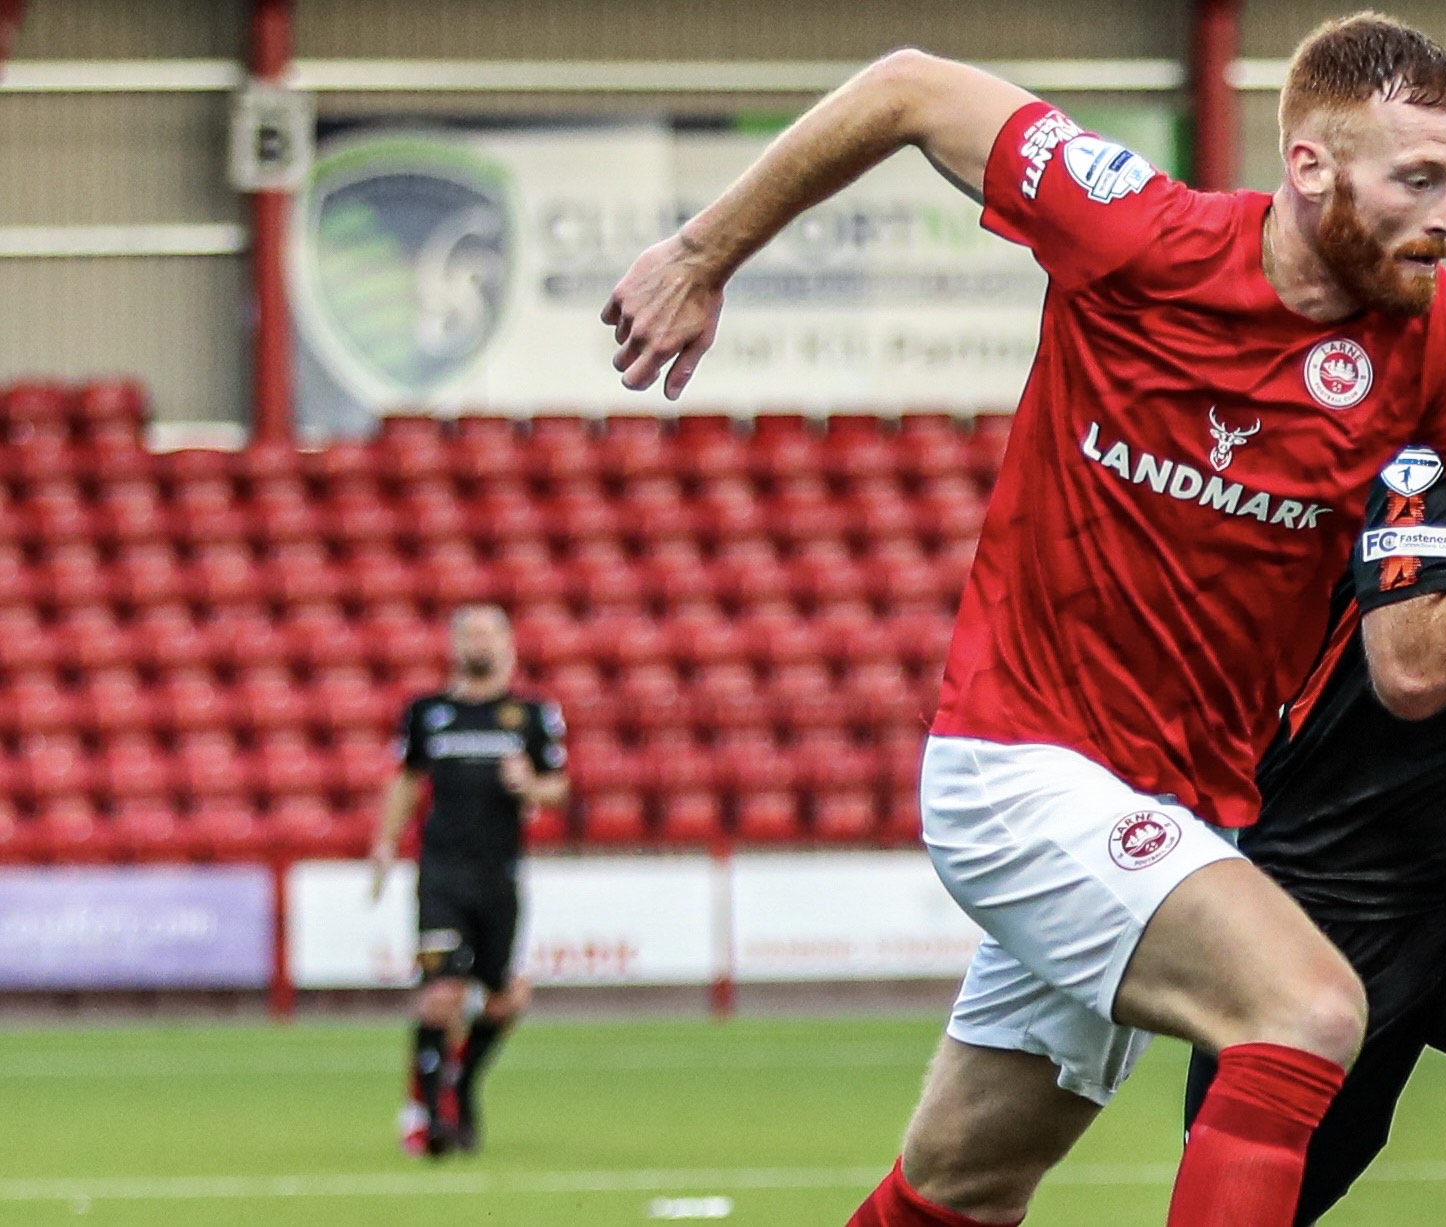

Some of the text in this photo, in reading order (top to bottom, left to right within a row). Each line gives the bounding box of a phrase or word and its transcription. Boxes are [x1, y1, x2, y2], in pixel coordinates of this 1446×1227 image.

[1320, 342, 1364, 361] LARNE
[1083, 421, 1333, 530] LANDMARK
[1366, 531, 1397, 556] FC
[1112, 813, 1154, 842] LARNE
